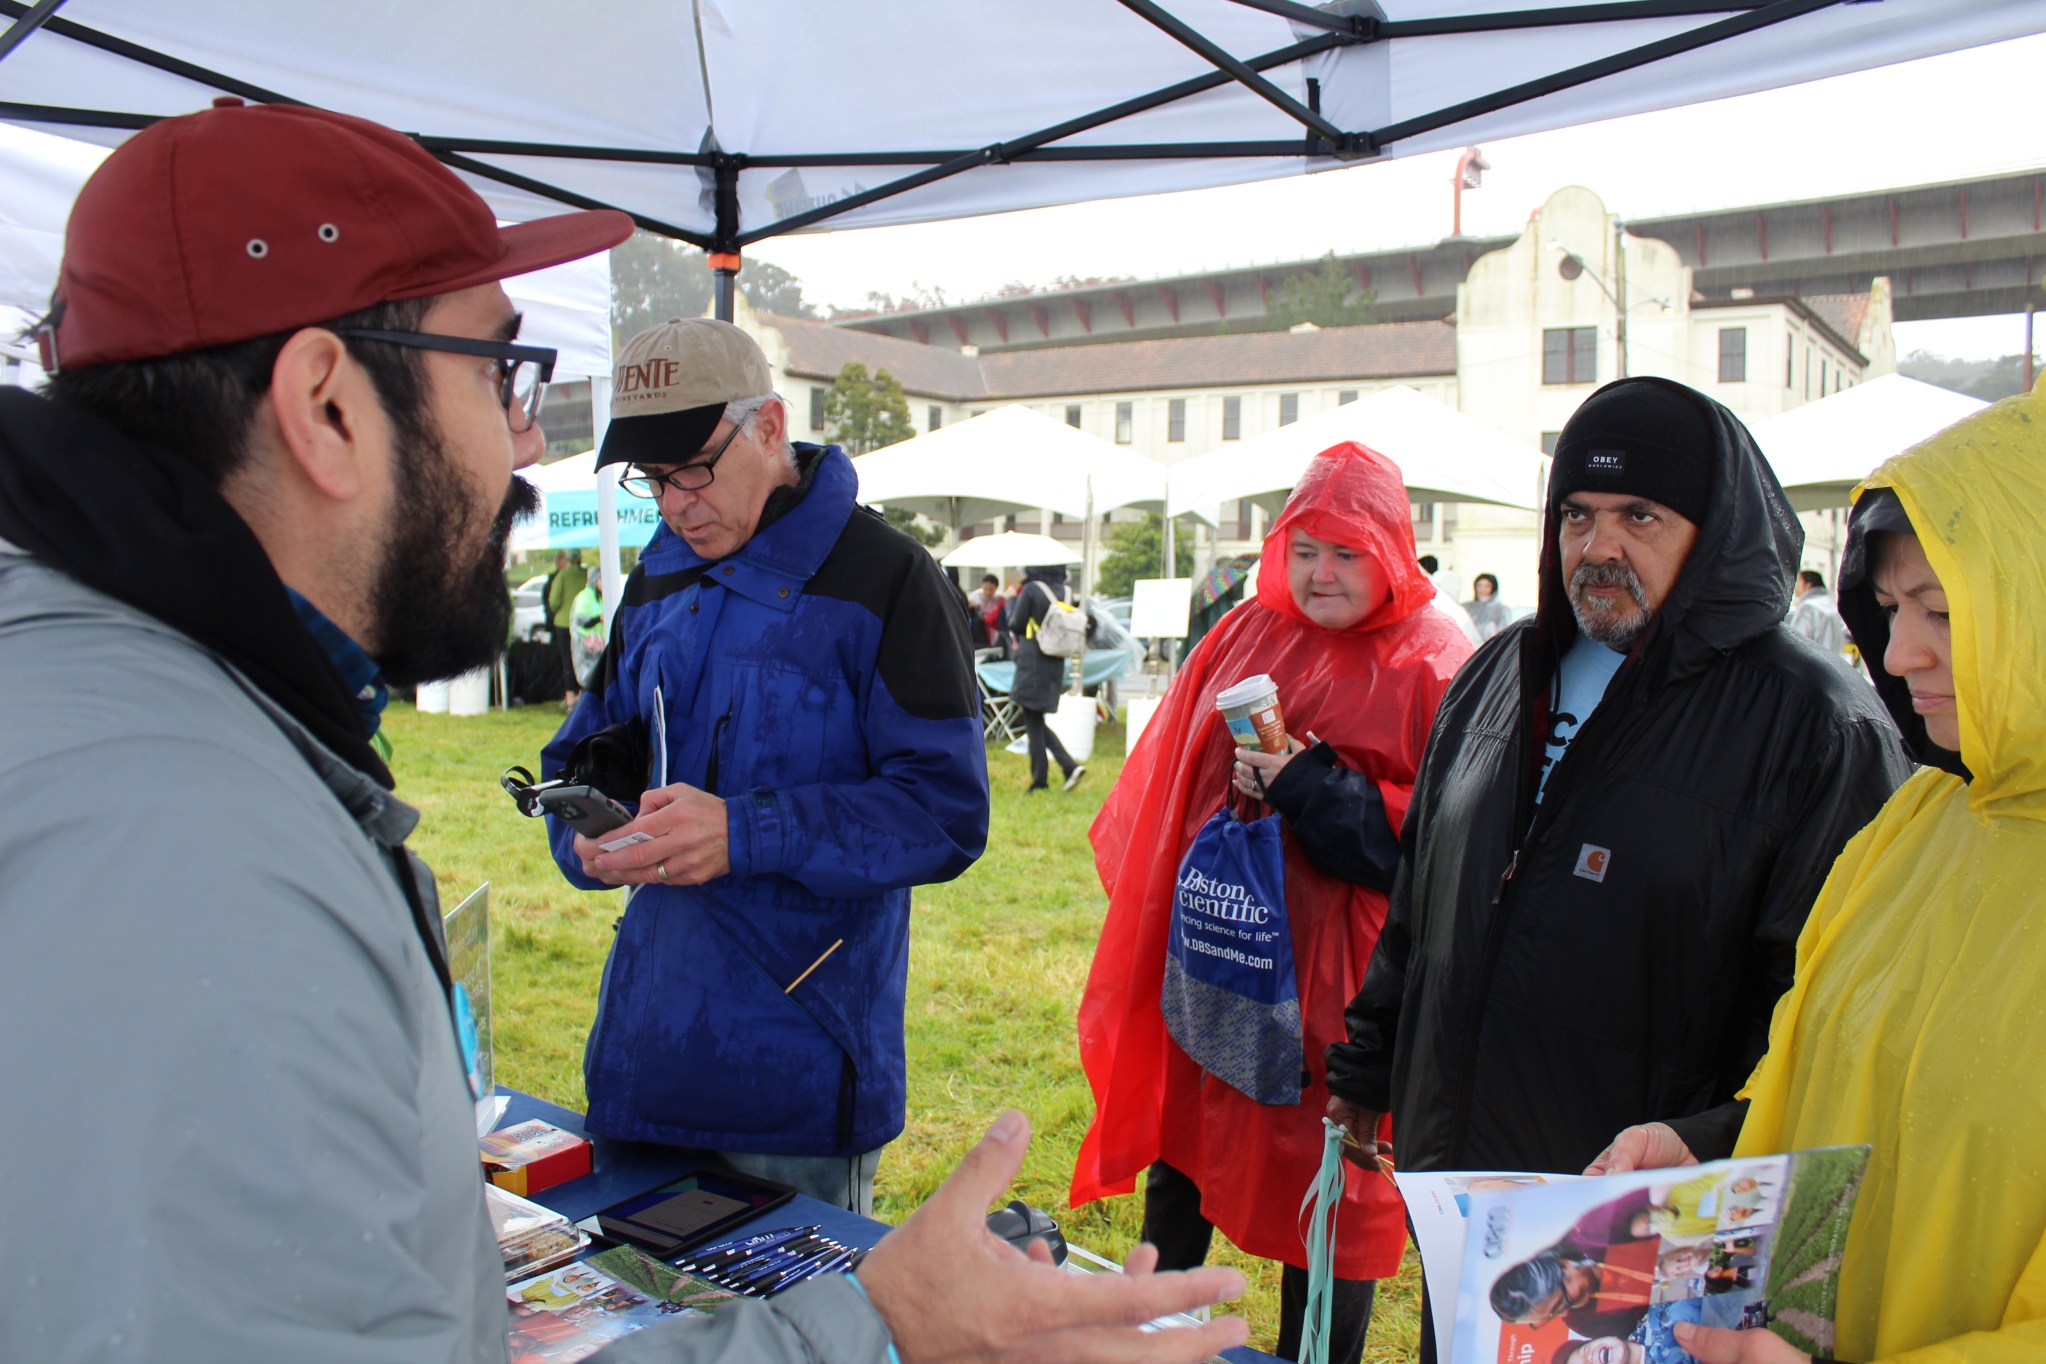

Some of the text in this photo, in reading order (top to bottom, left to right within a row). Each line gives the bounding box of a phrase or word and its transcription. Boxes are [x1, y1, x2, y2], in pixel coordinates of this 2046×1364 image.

[1592, 456, 1618, 464] OBEY
[549, 508, 662, 528] REFRHME
[1178, 889, 1269, 924] cientific
[1204, 922, 1236, 938] science
[1238, 930, 1252, 941] for
